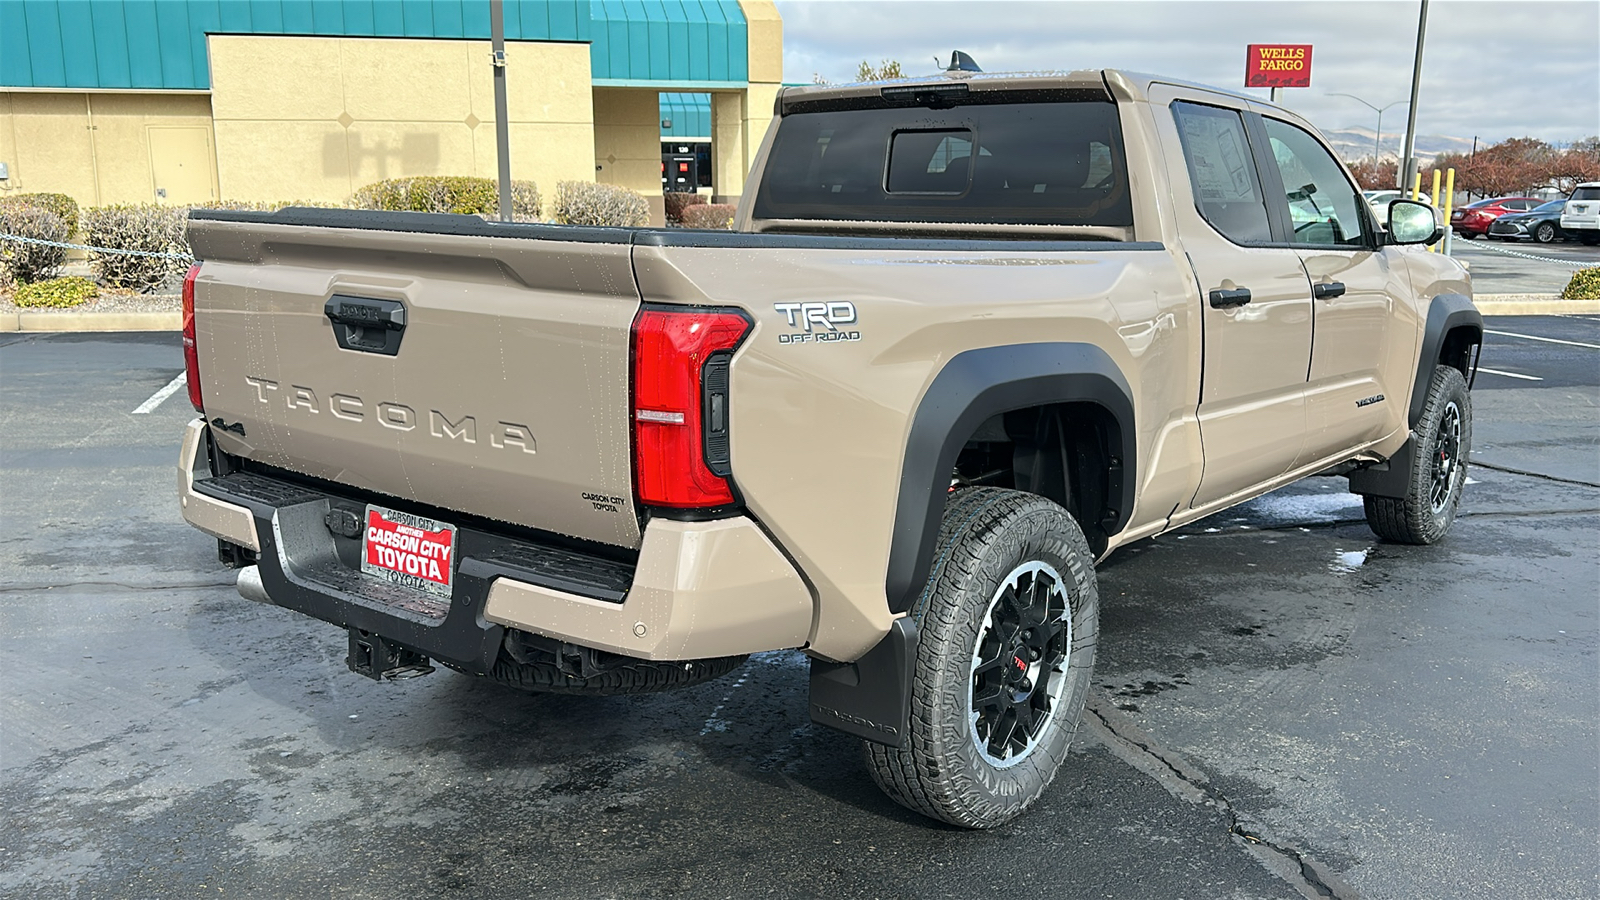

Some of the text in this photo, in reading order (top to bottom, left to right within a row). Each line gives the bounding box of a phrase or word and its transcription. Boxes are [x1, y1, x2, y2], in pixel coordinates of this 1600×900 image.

[1259, 48, 1305, 59] WELLS
[1259, 60, 1304, 71] FARGO
[341, 303, 380, 321] TOYOTA
[774, 300, 858, 332] TRD
[778, 331, 862, 345] OFF ROAD
[245, 375, 537, 454] TACOMA
[581, 492, 625, 505] CARSON CITY
[592, 502, 618, 513] TOYOTA
[387, 510, 435, 531] CARSON CITY
[396, 525, 424, 538] ANOTHER
[368, 527, 451, 560] CARSON CITY
[375, 545, 443, 580] TOYOTA
[386, 570, 426, 590] TOYOTA
